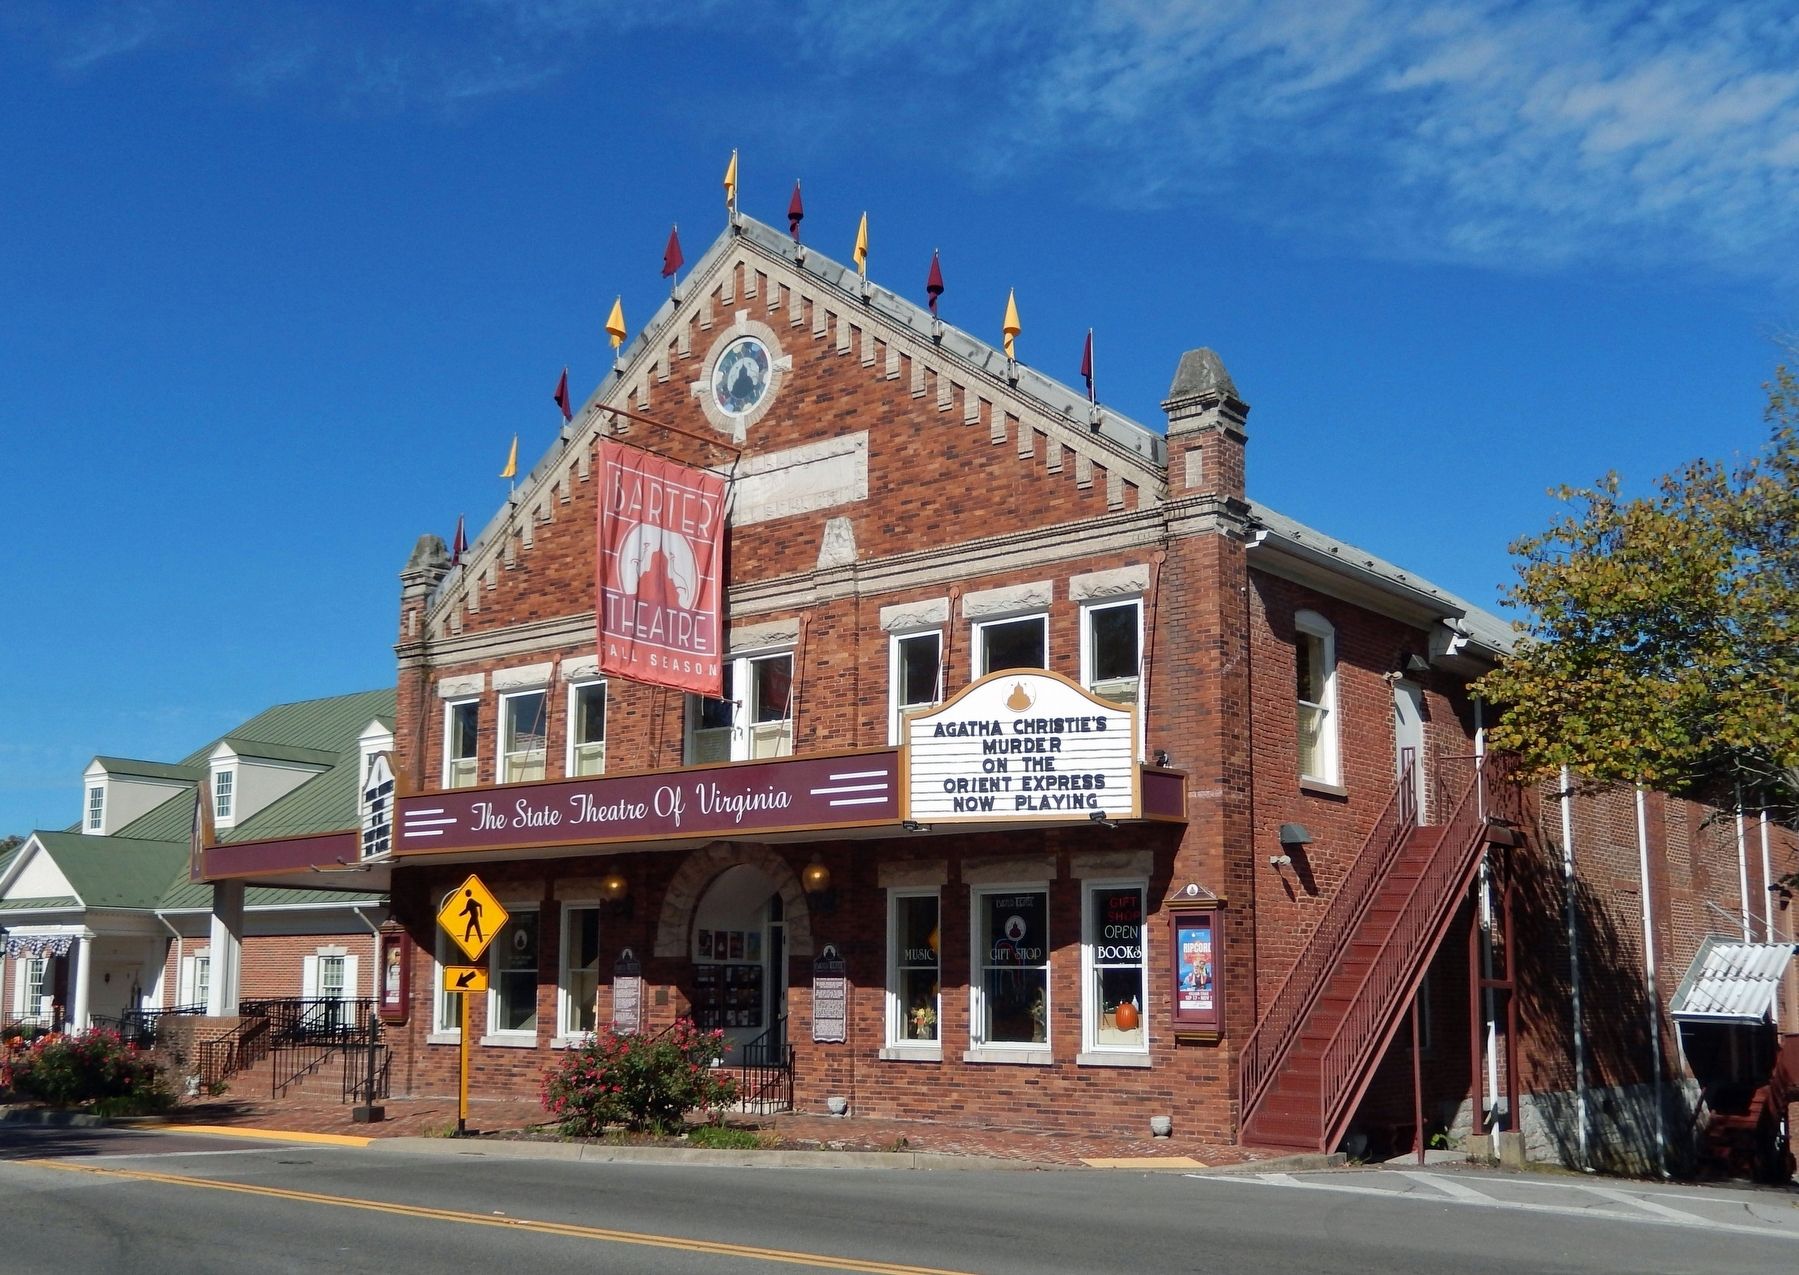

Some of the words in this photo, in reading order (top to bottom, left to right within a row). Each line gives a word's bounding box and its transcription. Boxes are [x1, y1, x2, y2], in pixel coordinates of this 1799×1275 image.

[615, 471, 713, 538] BARTER
[606, 593, 707, 651] THEATRE
[610, 643, 638, 663] ALL
[650, 653, 717, 676] SEASON
[934, 720, 1003, 737] AGATHA
[1013, 716, 1107, 735] CHRISTIE'S
[982, 737, 1062, 755] MURDER
[982, 756, 1008, 774] ON
[1022, 756, 1056, 772] THE
[943, 776, 1012, 793] ORIENT
[1022, 774, 1106, 792] EXPRESS
[470, 802, 507, 831] The
[513, 799, 562, 828] State
[570, 793, 649, 824] Theatre
[654, 785, 686, 828] Of
[696, 782, 792, 823] Virginia
[953, 796, 995, 813] NOW
[1015, 793, 1098, 811] PLAYING
[1104, 924, 1139, 939] OPEN
[904, 948, 935, 961] MUSIC
[990, 948, 1009, 961] GIFT
[1014, 946, 1042, 961] SHOP
[1097, 945, 1142, 959] BOOKS
